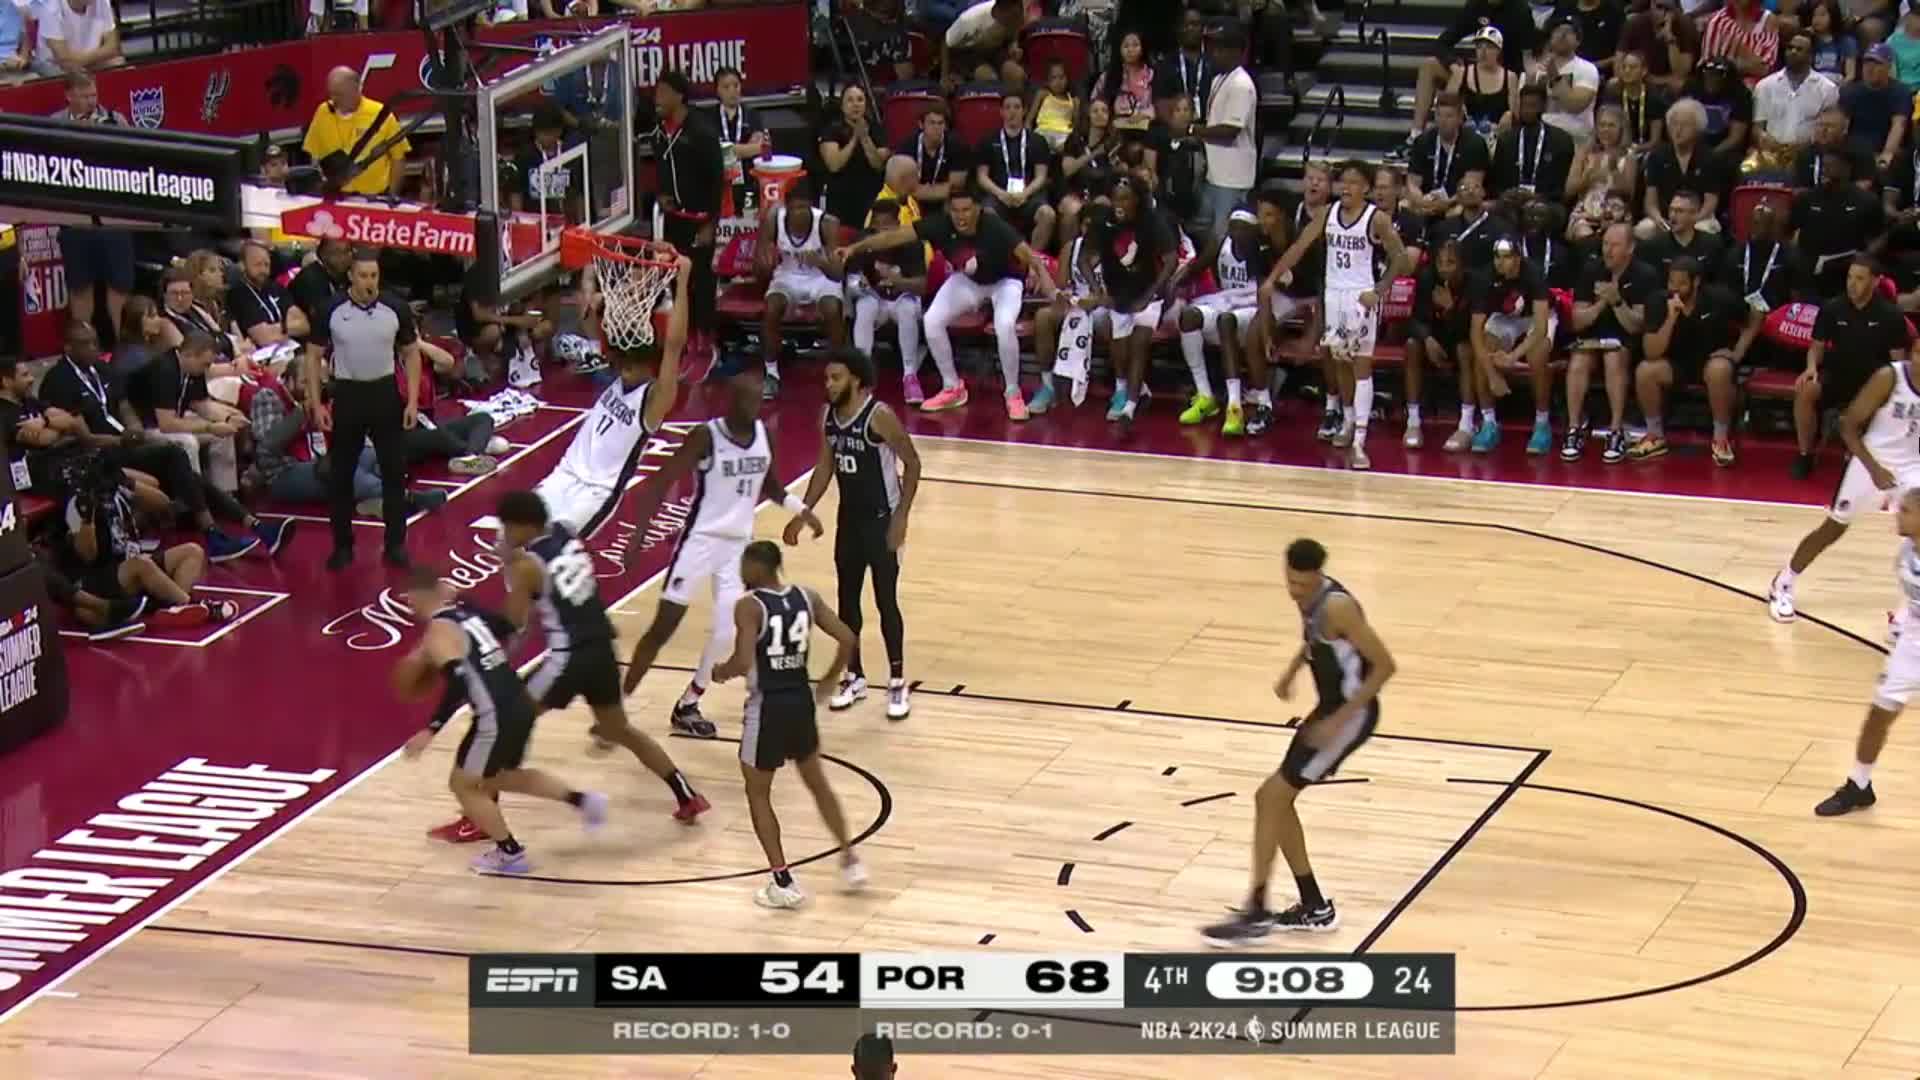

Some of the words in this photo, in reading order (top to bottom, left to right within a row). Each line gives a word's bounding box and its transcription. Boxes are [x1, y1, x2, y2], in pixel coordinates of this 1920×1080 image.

[2, 150, 215, 204] #NBA2KSummerLeague
[764, 183, 780, 201] G
[1335, 250, 1351, 269] 53
[596, 413, 614, 436] 17
[835, 452, 858, 474] 30
[766, 610, 809, 656] 14
[32, 757, 338, 872] LEAGUE
